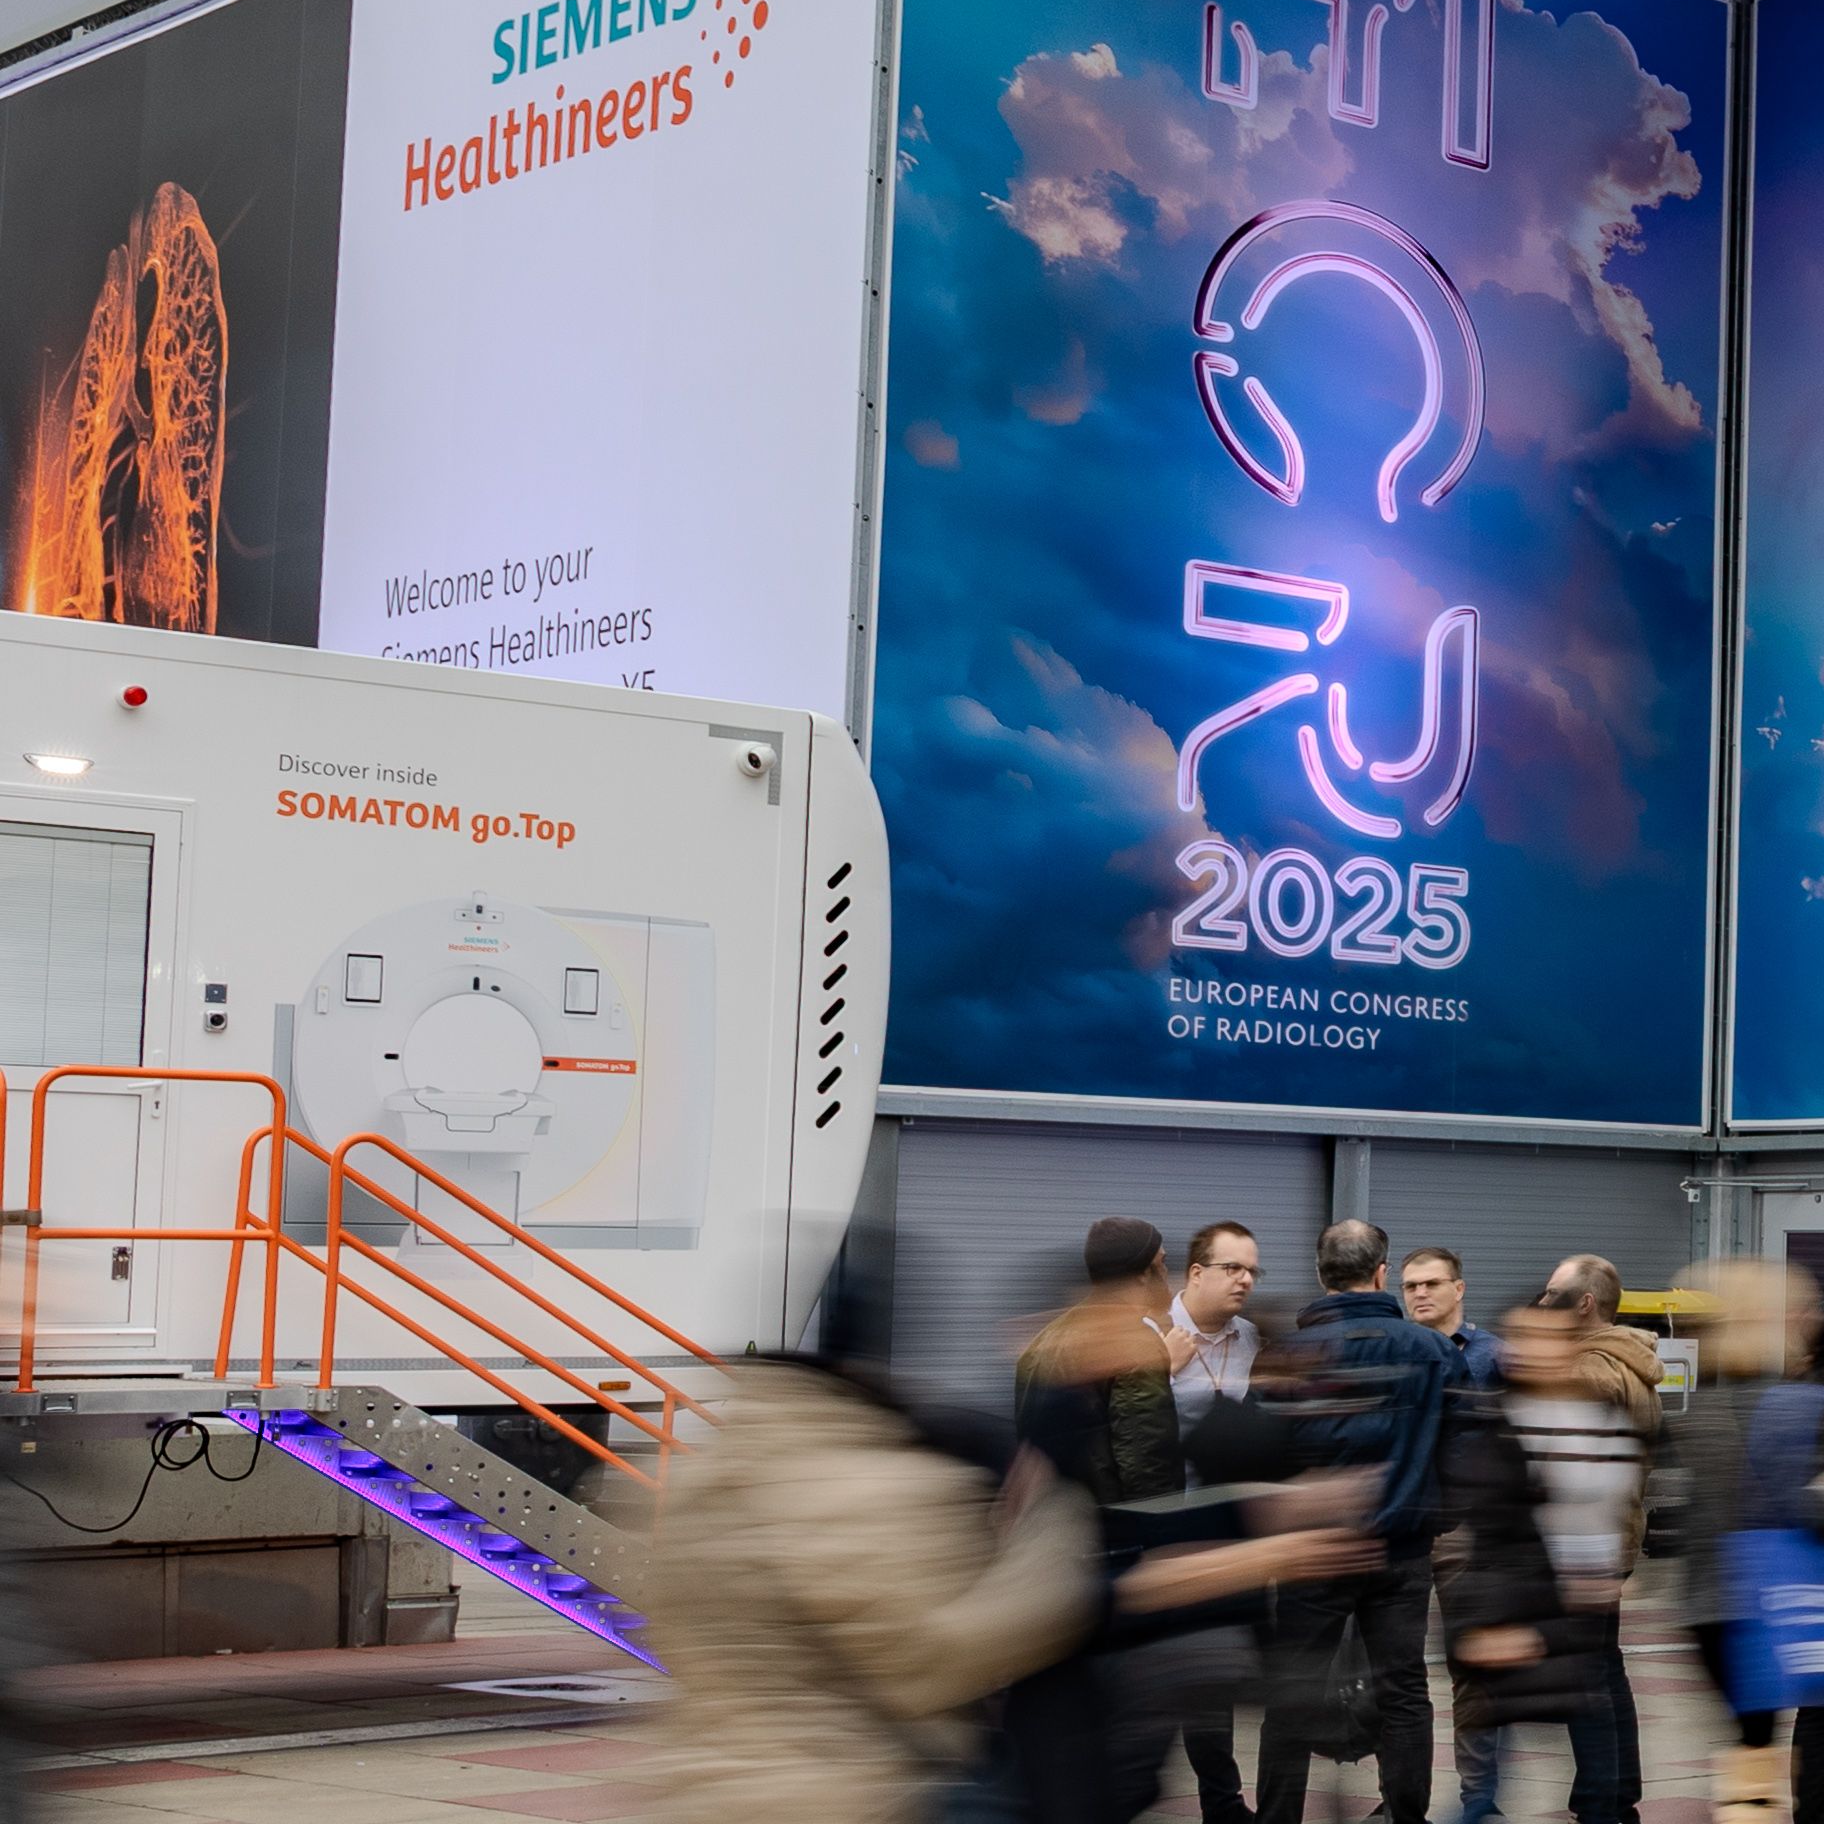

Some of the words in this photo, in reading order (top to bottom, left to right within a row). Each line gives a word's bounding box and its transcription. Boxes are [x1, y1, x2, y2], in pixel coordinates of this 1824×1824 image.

[403, 62, 694, 212] Healthineers
[385, 569, 494, 619] Welcome
[503, 558, 527, 596] to
[533, 546, 594, 603] your
[488, 607, 653, 669] Healthineers
[278, 753, 370, 780] Discover
[376, 763, 438, 787] inside
[276, 789, 460, 833] SOMATOM
[470, 812, 576, 849] go.Top
[1171, 840, 1472, 969] 2025
[1168, 978, 1319, 1012] EUROPEAN
[1330, 990, 1470, 1023] CONGRESS
[1167, 1014, 1206, 1040] OF
[1215, 1018, 1382, 1051] RADIOLOGY
